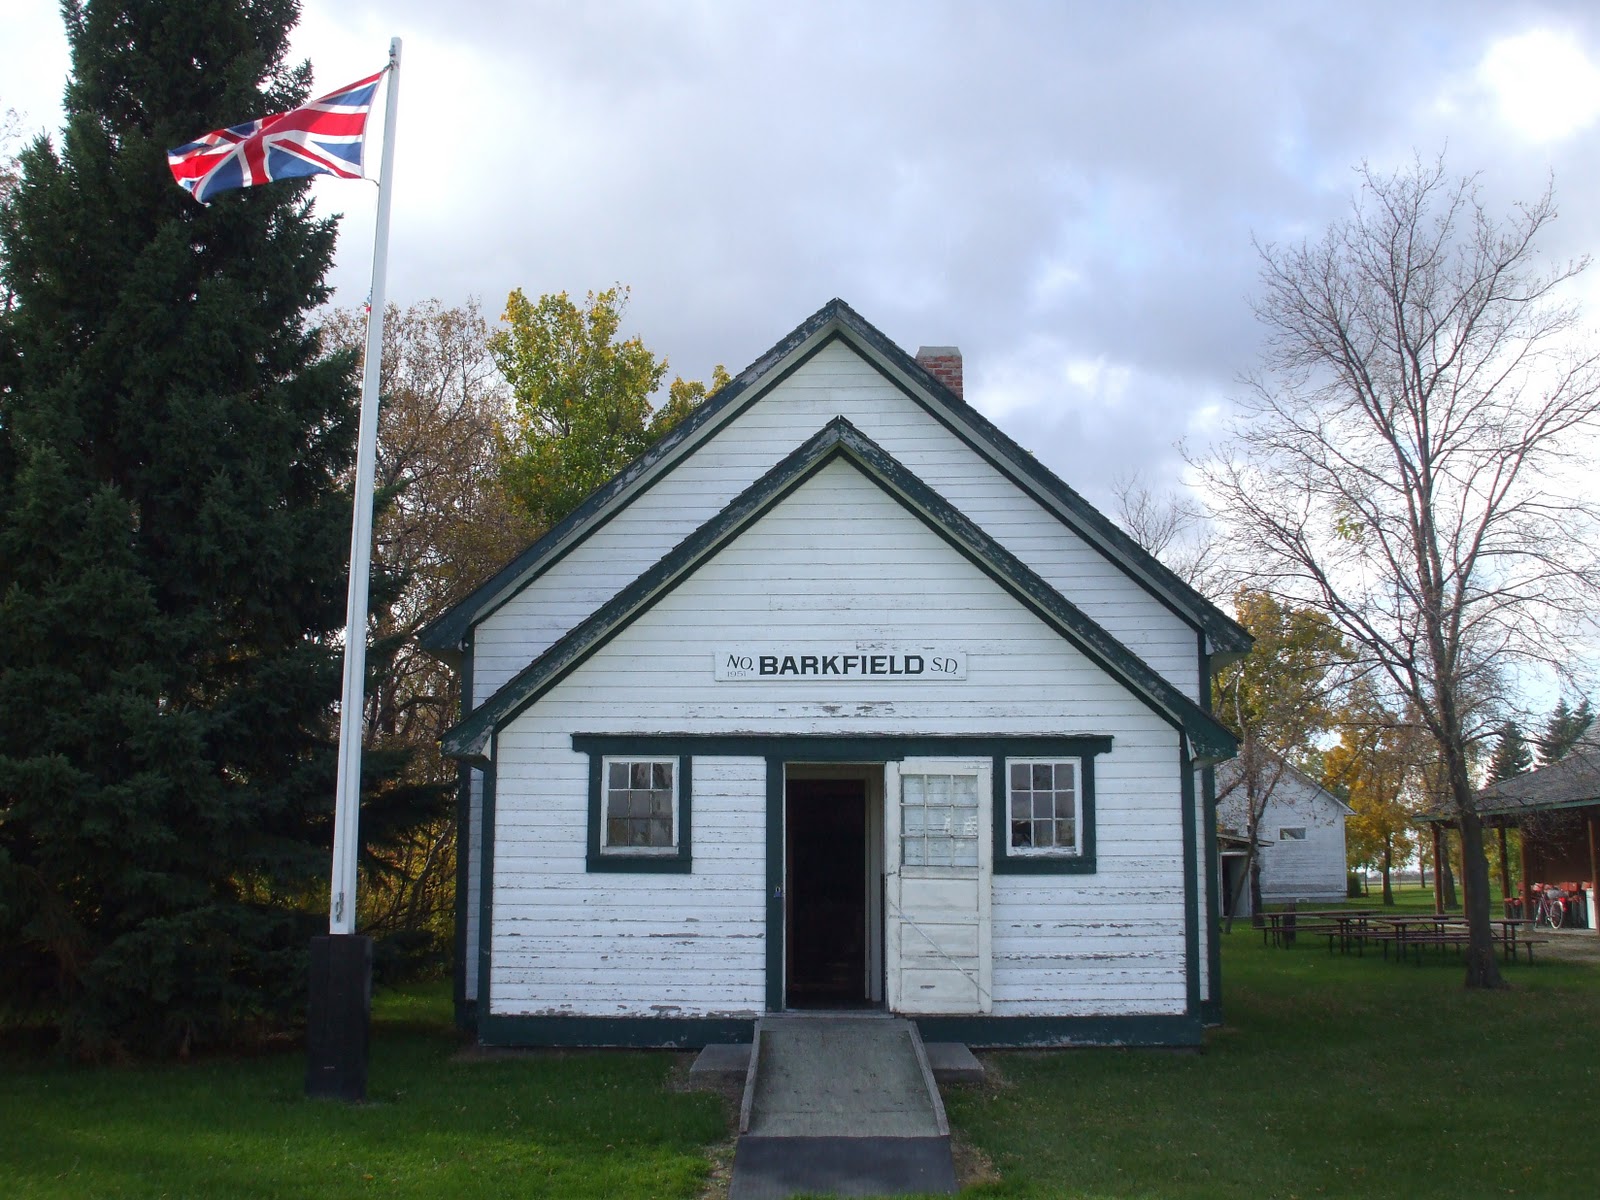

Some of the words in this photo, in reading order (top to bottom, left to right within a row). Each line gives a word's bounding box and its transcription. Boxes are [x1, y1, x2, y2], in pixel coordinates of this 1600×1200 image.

[727, 654, 754, 671] NO.
[759, 655, 925, 675] BARKFIELD
[930, 656, 958, 675] S.D.
